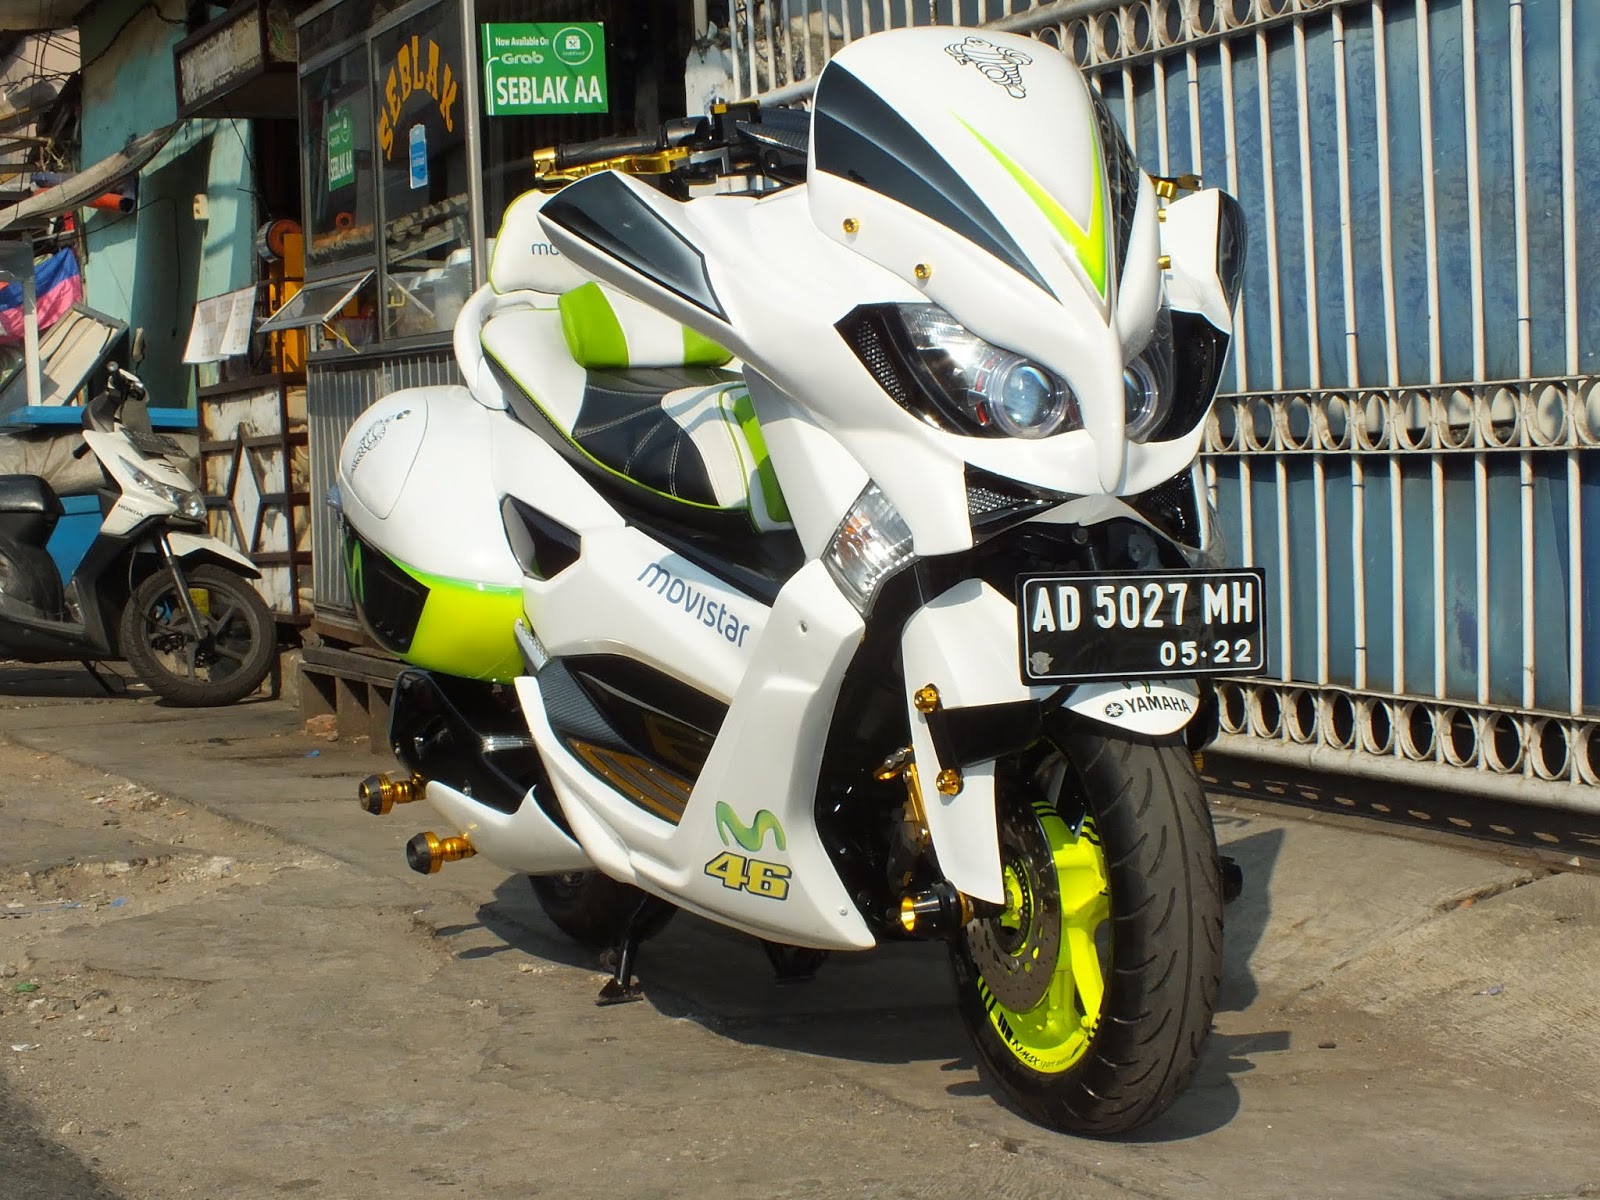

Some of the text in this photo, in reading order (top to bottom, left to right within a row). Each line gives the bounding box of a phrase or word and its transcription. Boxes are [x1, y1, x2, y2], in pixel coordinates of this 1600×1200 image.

[495, 36, 550, 46] Now Available On
[501, 51, 544, 65] Grab
[378, 35, 458, 162] SEBLAK
[496, 75, 603, 105] SEBLAK AA
[117, 503, 144, 518] HONDA
[637, 562, 750, 648] movistar
[1032, 581, 1253, 633] AD 5027 MH
[1124, 695, 1192, 714] YAMAHA
[704, 851, 793, 901] 46
